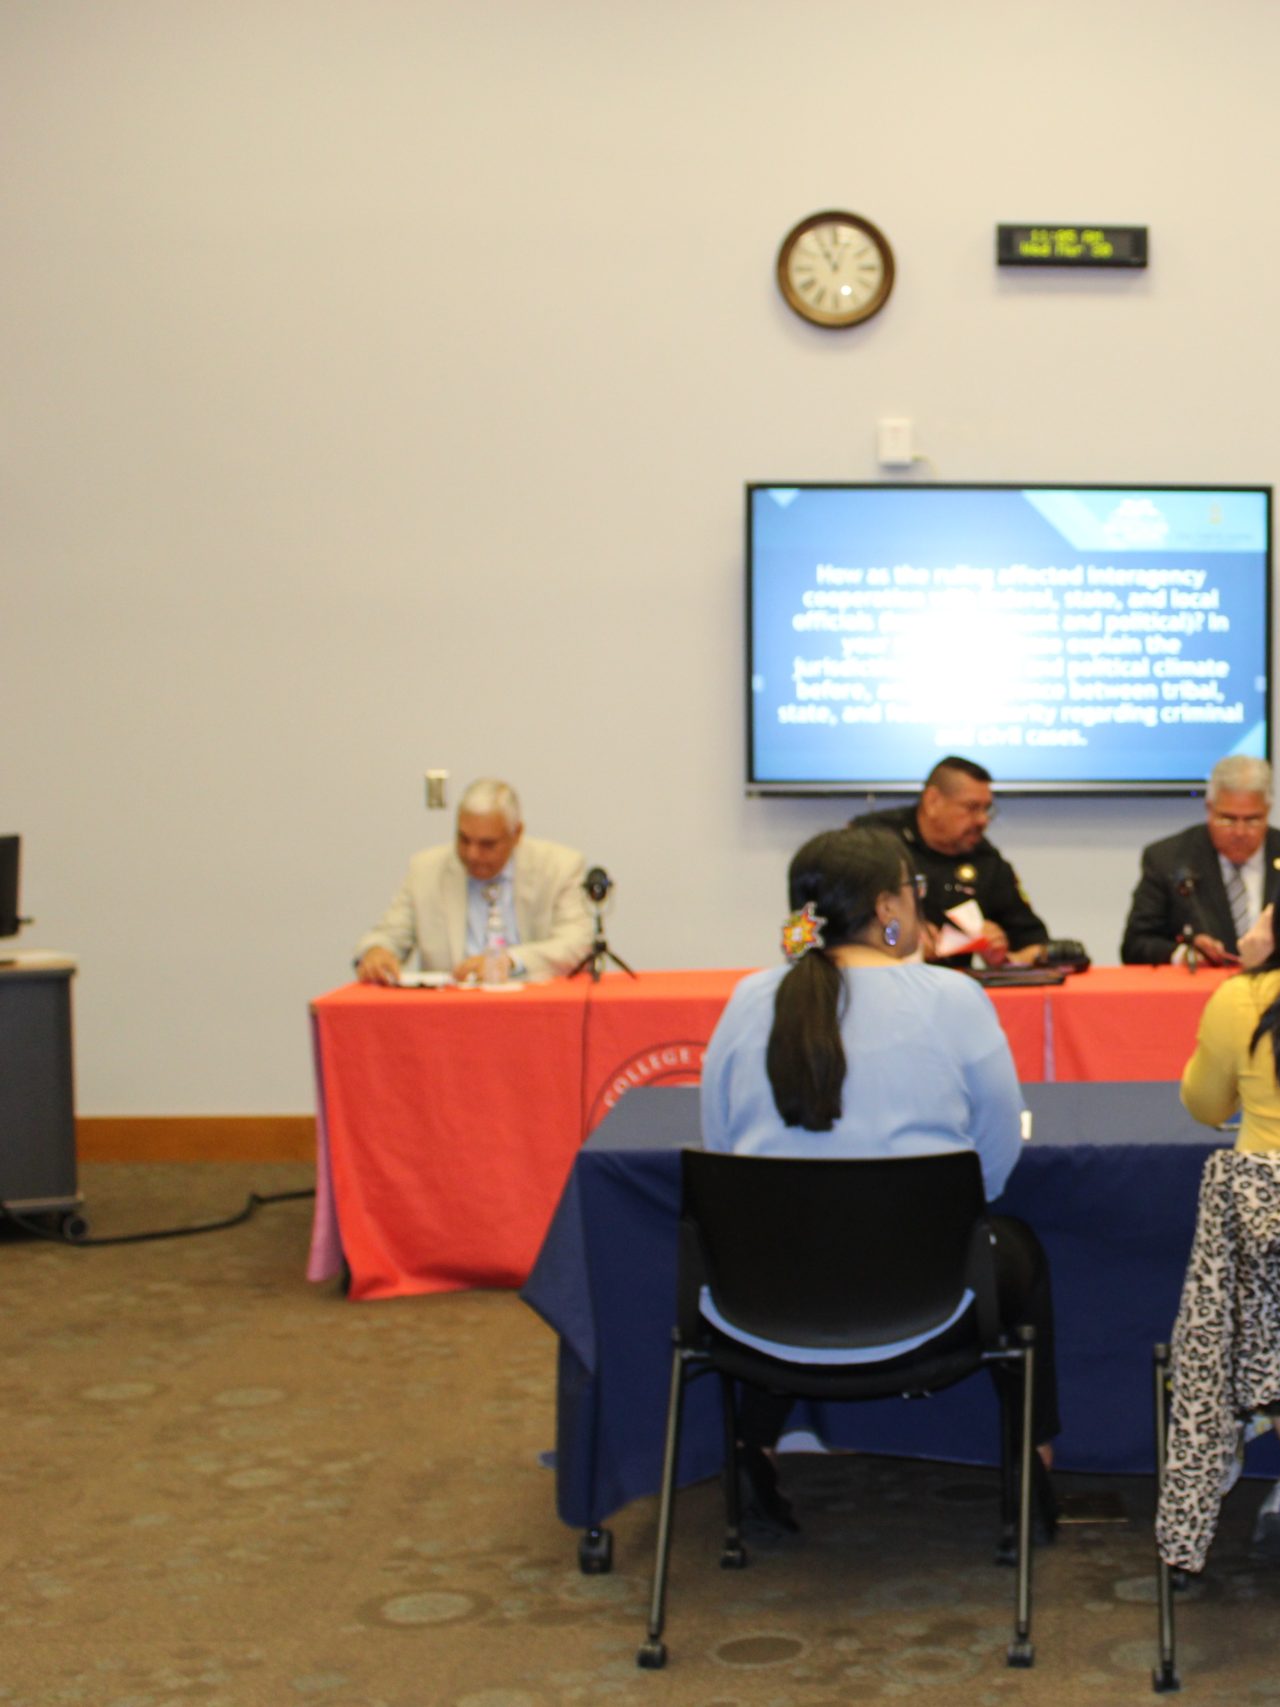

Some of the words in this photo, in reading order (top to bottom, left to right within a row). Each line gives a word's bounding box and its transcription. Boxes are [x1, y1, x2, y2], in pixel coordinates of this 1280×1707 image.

[816, 565, 863, 585] How
[866, 568, 890, 585] as
[893, 565, 929, 585] the
[933, 565, 994, 592] ruling
[997, 565, 1084, 585] affected
[803, 586, 926, 613] cooperation
[1064, 589, 1123, 611] state,
[1127, 588, 1167, 609] and
[1170, 588, 1219, 609] local
[792, 610, 874, 632] officials
[1062, 611, 1102, 632] and
[1145, 634, 1181, 655] the
[1067, 656, 1149, 682] political
[1153, 656, 1230, 677] climate
[797, 680, 872, 703] before,
[1069, 680, 1158, 700] between
[1162, 680, 1225, 703] tribal,
[778, 704, 837, 726] state,
[842, 703, 882, 723] and
[1061, 703, 1157, 726] regarding
[1160, 702, 1243, 723] criminal
[1026, 728, 1087, 746] cases.
[604, 1047, 689, 1107] COLLEGE
